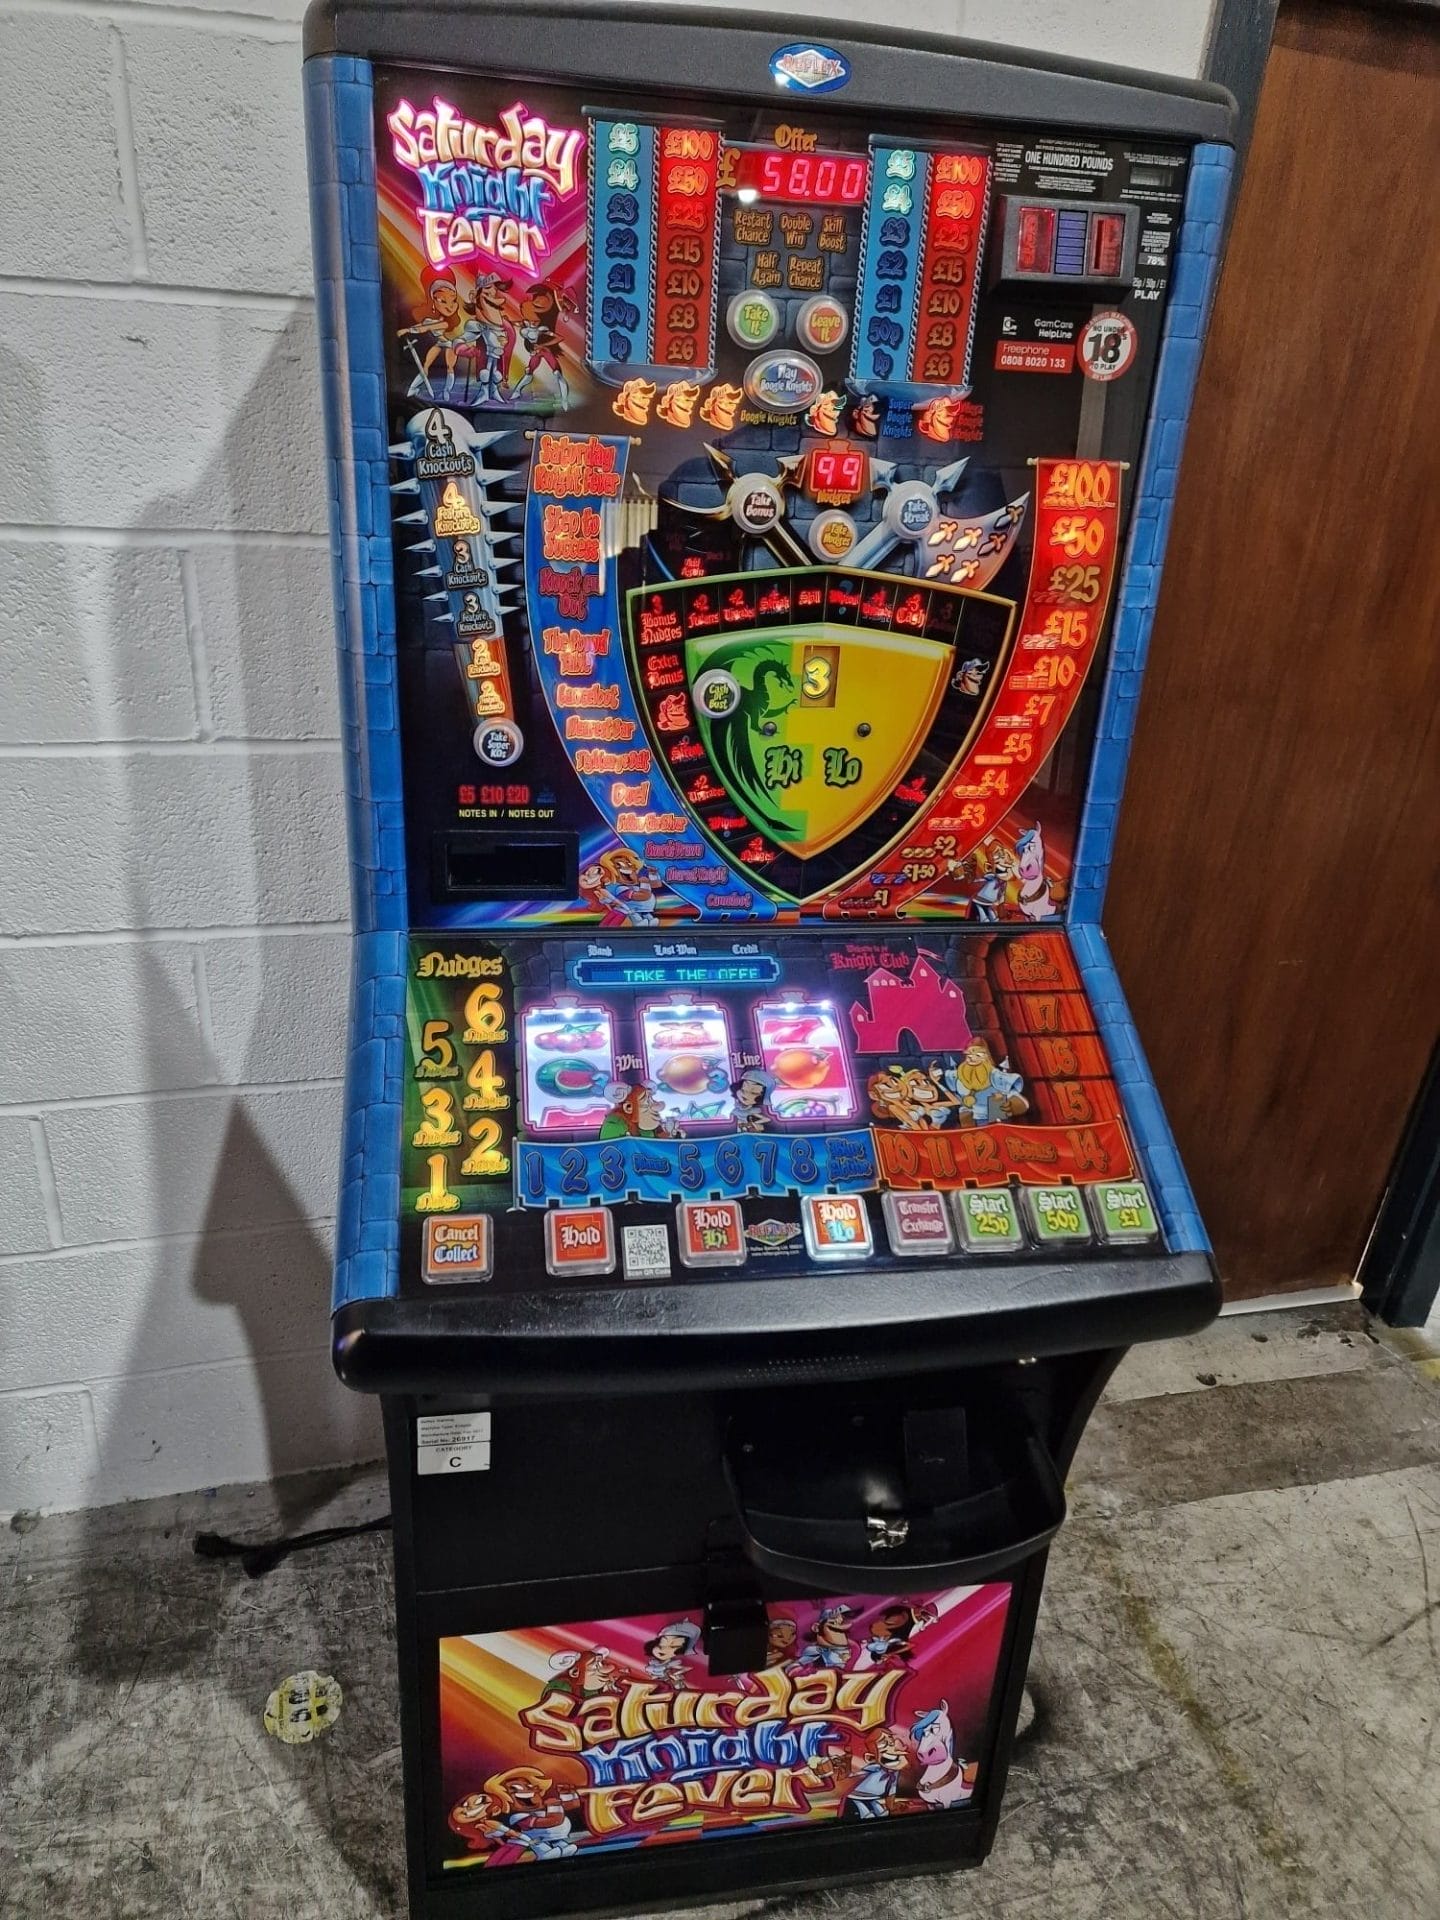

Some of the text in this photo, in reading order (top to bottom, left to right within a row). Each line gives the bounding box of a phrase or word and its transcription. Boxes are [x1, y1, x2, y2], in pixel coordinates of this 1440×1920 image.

[389, 96, 584, 199] Saturday
[664, 130, 713, 160] £100
[775, 124, 817, 151] Offer
[936, 156, 982, 185] £100
[1025, 150, 1042, 164] ONE
[1043, 153, 1081, 168] HUNDRED
[1081, 156, 1113, 171] POUNDS
[608, 158, 638, 190] £4
[668, 166, 708, 196] £50
[715, 148, 863, 199] £ 58.00
[418, 162, 550, 227] Knight
[936, 190, 975, 219] £50
[608, 194, 637, 224] £3
[667, 202, 706, 231] £25
[735, 211, 843, 233] Restart Double Skill
[418, 208, 546, 273] Fever
[606, 230, 636, 256] £2
[668, 236, 702, 264] £15
[736, 227, 845, 250] Chance Win Boost
[757, 252, 822, 275] Half Repeat
[932, 256, 964, 283] £15
[1147, 255, 1166, 266] 78%
[608, 264, 633, 291] £1
[666, 270, 700, 296] £10
[753, 268, 821, 288] Again Chance
[928, 289, 960, 314] £10
[1134, 290, 1161, 300] PLAY
[602, 298, 638, 330] 50p
[668, 304, 696, 329] £8
[745, 304, 769, 321] Take
[812, 313, 840, 329] Leave
[1034, 319, 1074, 329] GamCare
[869, 317, 901, 346] 50p
[927, 322, 954, 347] £8
[1038, 329, 1072, 339] HelpLine
[667, 336, 695, 361] £6
[1003, 343, 1050, 355] Freephone
[777, 363, 797, 381] Play
[924, 353, 950, 378] £6
[1001, 356, 1066, 368] 0808 8020 133
[760, 379, 813, 393] Boogie Knights
[426, 409, 452, 444] 4
[740, 409, 797, 426] Boogie Knights
[429, 444, 453, 459] Cash
[418, 457, 473, 475] Knockouts
[1046, 462, 1111, 505] £100
[749, 493, 772, 505] Take
[906, 499, 926, 512] Take
[545, 505, 600, 537] Step to
[746, 505, 774, 518] Bonus
[435, 517, 480, 534] Knockouts
[831, 523, 848, 534] Take
[1050, 515, 1104, 557] £50
[544, 532, 600, 561] Success
[540, 567, 582, 596] Knock
[1048, 563, 1100, 603] £25
[640, 612, 677, 629] Bonus
[896, 608, 926, 628] Cash
[1043, 610, 1088, 648] £15
[543, 627, 568, 655] The
[640, 626, 682, 645] Nudges
[647, 654, 680, 671] Extra
[1032, 656, 1076, 687] £10
[647, 670, 684, 690] Bonus
[708, 684, 729, 695] Cash
[802, 656, 832, 699] 3
[709, 699, 729, 710] Bust
[1023, 695, 1056, 726] £7
[487, 741, 510, 751] Super
[490, 732, 508, 742] Take
[1002, 732, 1033, 762] £5
[765, 745, 862, 787] Hi Lo
[458, 785, 475, 804] £5
[480, 785, 504, 804] £10
[506, 785, 529, 804] £20
[612, 781, 650, 807] Duel
[980, 769, 1009, 796] £4
[458, 809, 487, 818] NOTES
[489, 809, 498, 818] IN
[508, 810, 536, 818] NOTES
[538, 810, 555, 818] OUT
[962, 803, 986, 827] £3
[934, 835, 957, 857] £2
[874, 889, 889, 905] £1
[587, 944, 759, 957] Bank Last Credit
[831, 951, 910, 970] Knight Club
[417, 952, 503, 978] Nudges
[623, 969, 707, 982] TAKE THE
[464, 982, 506, 1033] 6
[1025, 994, 1059, 1031] 17
[423, 1021, 453, 1067] 5
[616, 1052, 761, 1073] Win Line
[1039, 1038, 1077, 1076] 16
[467, 1050, 506, 1099] 4
[422, 1088, 454, 1132] 3
[1052, 1081, 1093, 1122] 15
[468, 1117, 504, 1160] 2
[880, 1133, 919, 1175] 10
[924, 1137, 957, 1178] 11
[962, 1131, 1003, 1173] 12
[1066, 1129, 1108, 1172] 14
[427, 1153, 448, 1200] 1
[526, 1152, 544, 1195] 1
[560, 1148, 588, 1192] 2
[600, 1146, 625, 1189] 3
[679, 1143, 704, 1189] 5
[715, 1139, 742, 1184] 6
[754, 1141, 776, 1185] 7
[790, 1138, 818, 1182] 8
[818, 1201, 857, 1223] Hold
[898, 1201, 939, 1215] Transfer
[969, 1194, 1008, 1215] Start
[1038, 1191, 1077, 1213] Start
[1106, 1190, 1145, 1211] Start
[693, 1208, 732, 1231] Hold
[901, 1218, 944, 1234] Exchange
[976, 1213, 1009, 1235] 25p
[1046, 1209, 1079, 1231] 50p
[1119, 1208, 1141, 1227] £1
[434, 1226, 479, 1243] Cancel
[561, 1225, 601, 1249] Hold
[702, 1230, 728, 1250] Hi
[433, 1245, 478, 1263] Collect
[627, 1269, 643, 1277] Scan
[654, 1268, 671, 1276] Code
[450, 1456, 462, 1468] C
[525, 1666, 905, 1750] Saturday
[582, 1720, 843, 1788] Knight
[582, 1764, 825, 1830] Fever
